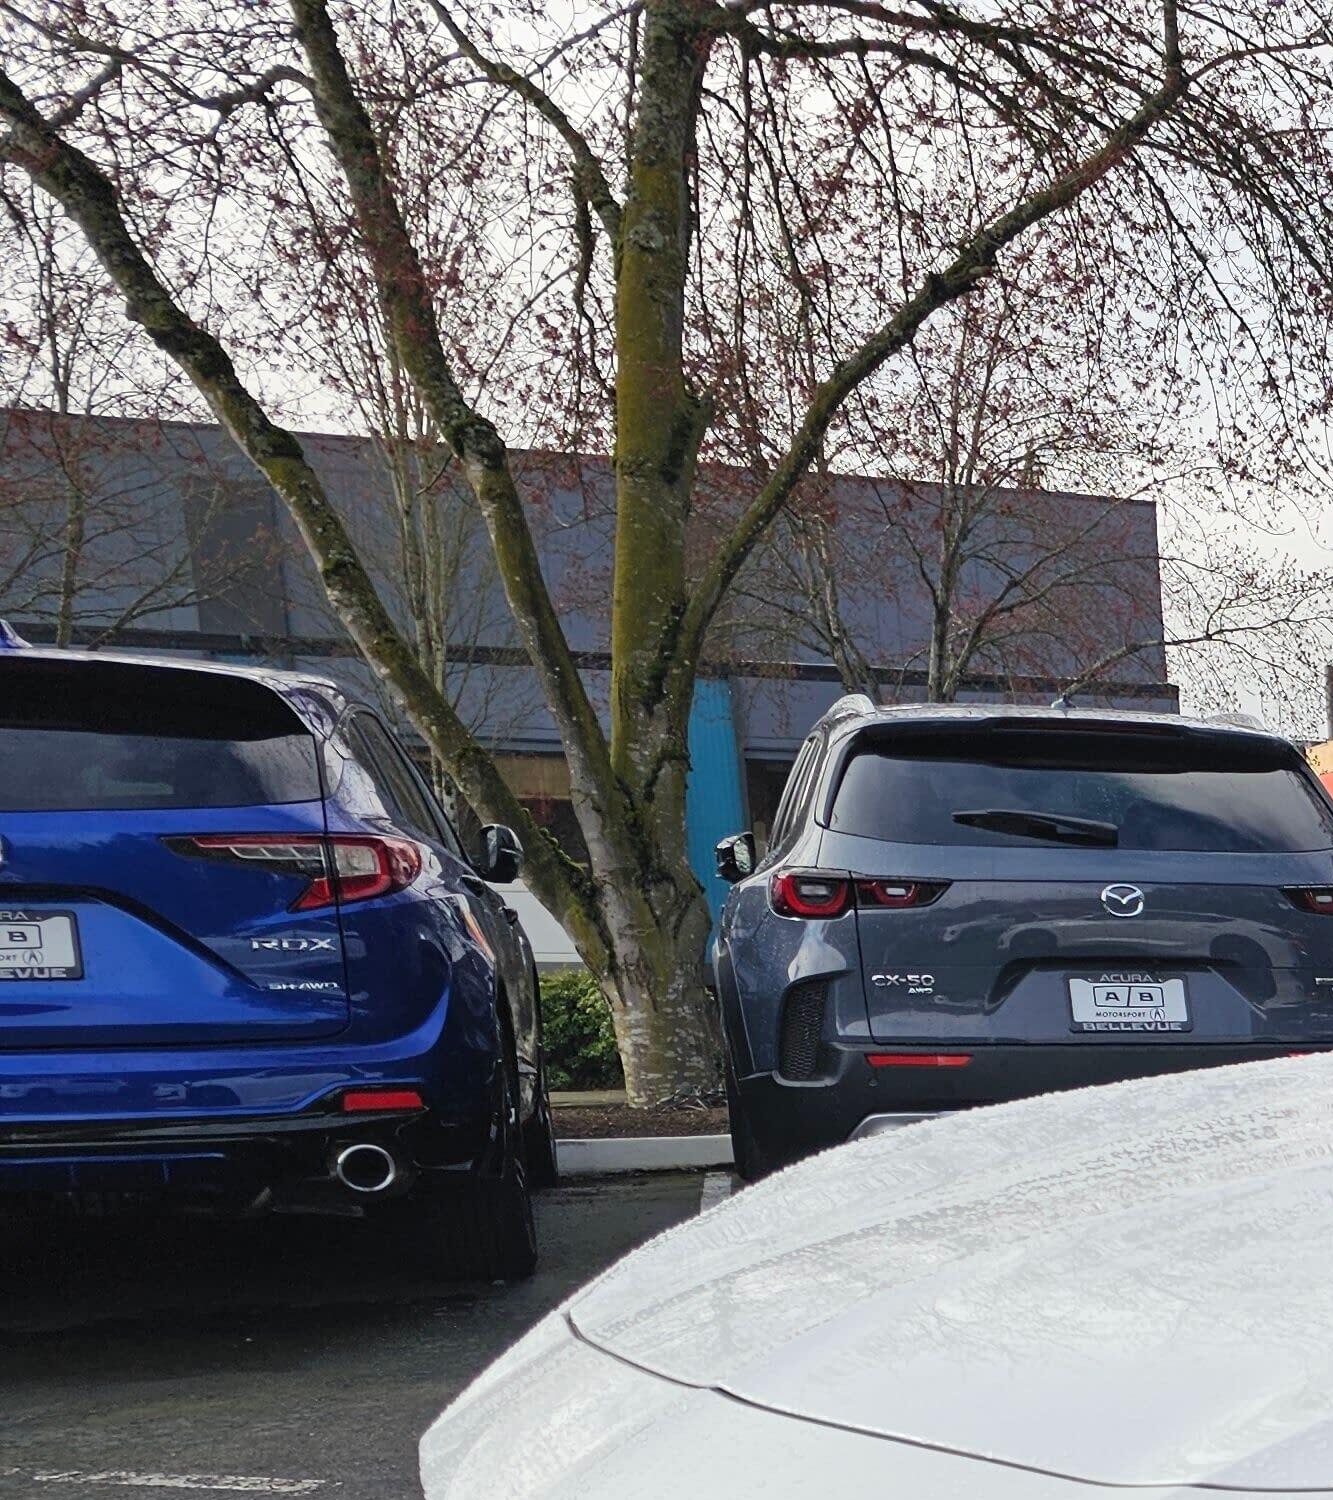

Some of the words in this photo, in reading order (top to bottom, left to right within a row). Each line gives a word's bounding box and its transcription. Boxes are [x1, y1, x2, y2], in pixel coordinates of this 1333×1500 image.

[250, 938, 337, 951] RDX
[871, 974, 935, 986] CX-50
[1099, 974, 1153, 983] ACURA
[1082, 1022, 1182, 1031] BELLEVUE
